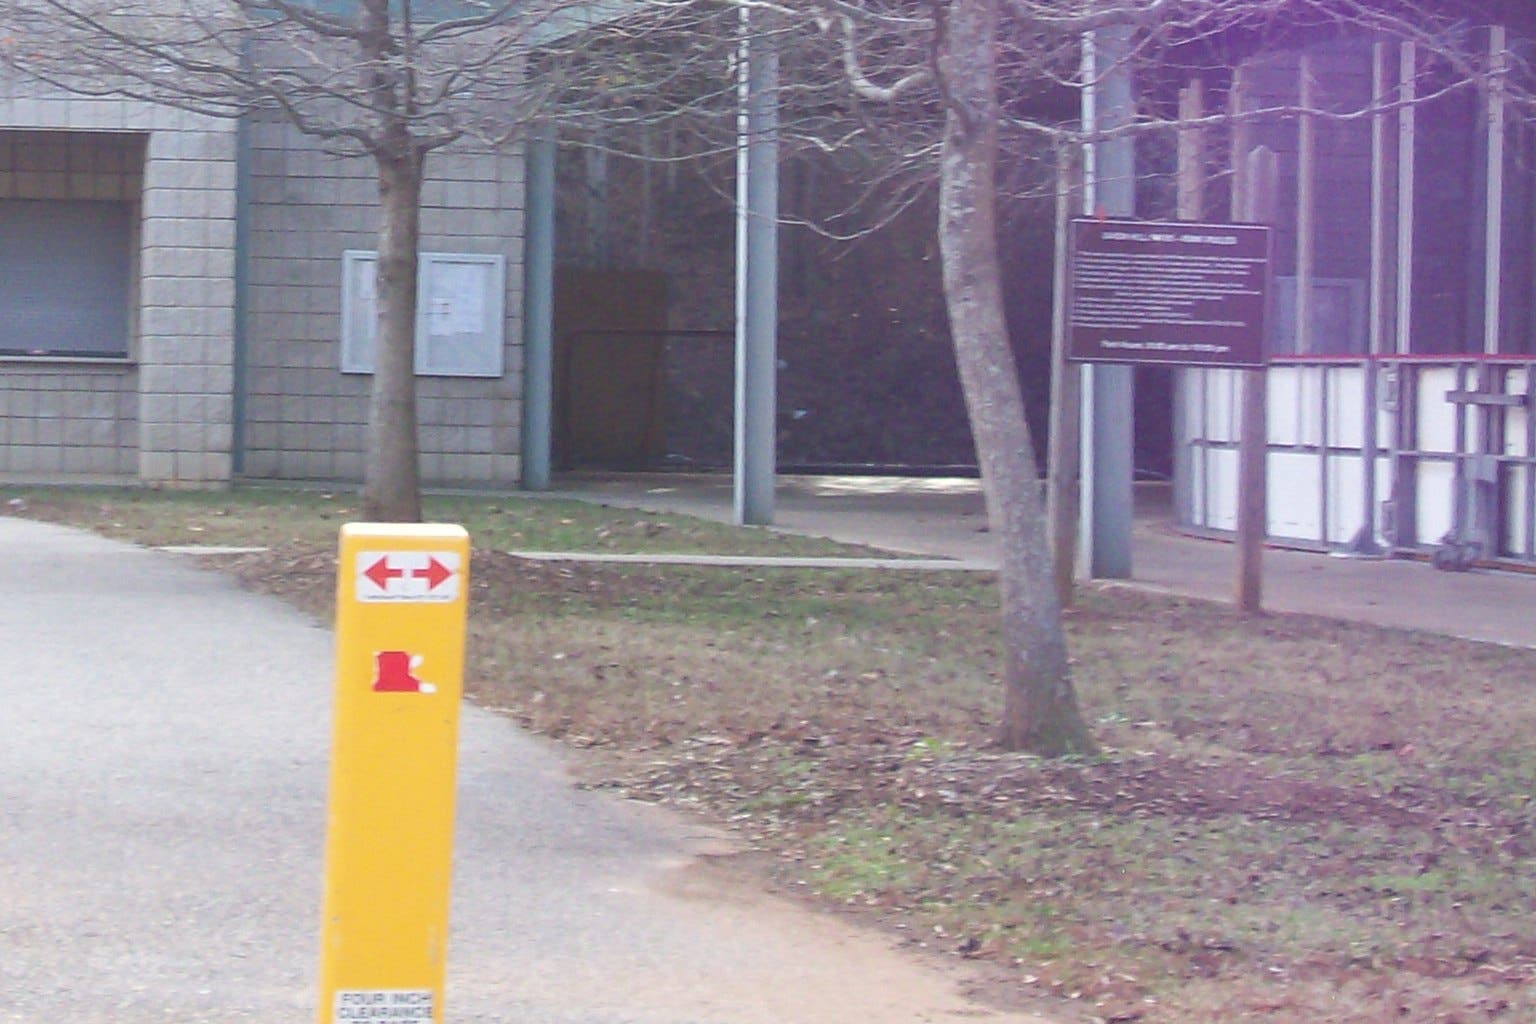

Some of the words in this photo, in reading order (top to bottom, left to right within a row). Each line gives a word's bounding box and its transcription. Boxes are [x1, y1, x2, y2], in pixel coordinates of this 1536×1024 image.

[342, 992, 384, 1006] FOUR
[392, 992, 432, 1005] INCH
[339, 1006, 433, 1019] CLEARANCE
